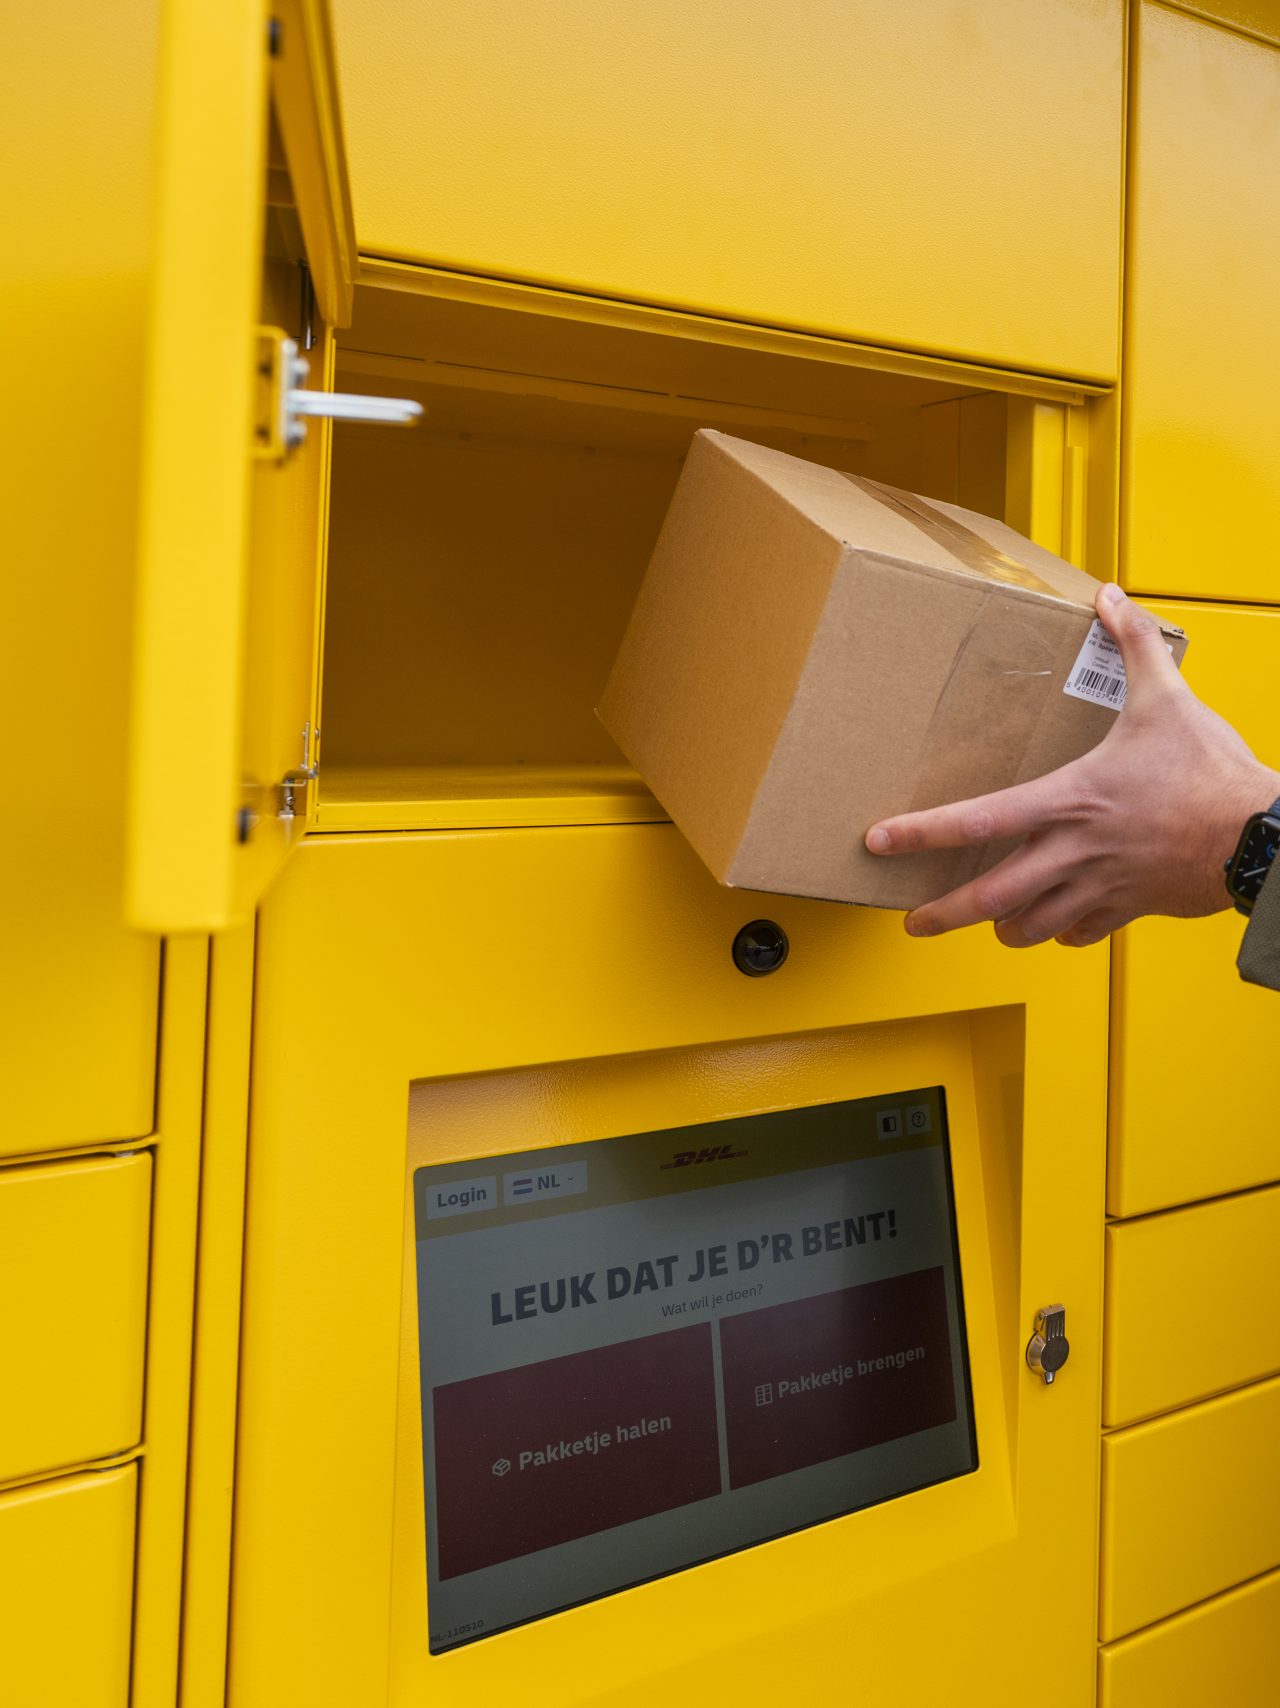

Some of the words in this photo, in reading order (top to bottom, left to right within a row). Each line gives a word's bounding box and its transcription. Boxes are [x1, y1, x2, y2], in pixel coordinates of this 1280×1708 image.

[667, 1145, 743, 1168] DHL
[437, 1187, 487, 1208] Login
[537, 1174, 561, 1191] NL
[491, 1272, 598, 1326] LEUK
[606, 1255, 680, 1300] DAT
[688, 1245, 729, 1283] JE
[802, 1209, 898, 1257] BENT!
[661, 1301, 687, 1317] Wat
[690, 1295, 710, 1311] wil
[711, 1292, 724, 1310] je
[726, 1284, 763, 1304] doen?
[778, 1363, 855, 1399] Pakketje
[857, 1345, 926, 1377] brengen
[518, 1432, 612, 1471] Pakketje
[616, 1414, 672, 1443] halen
